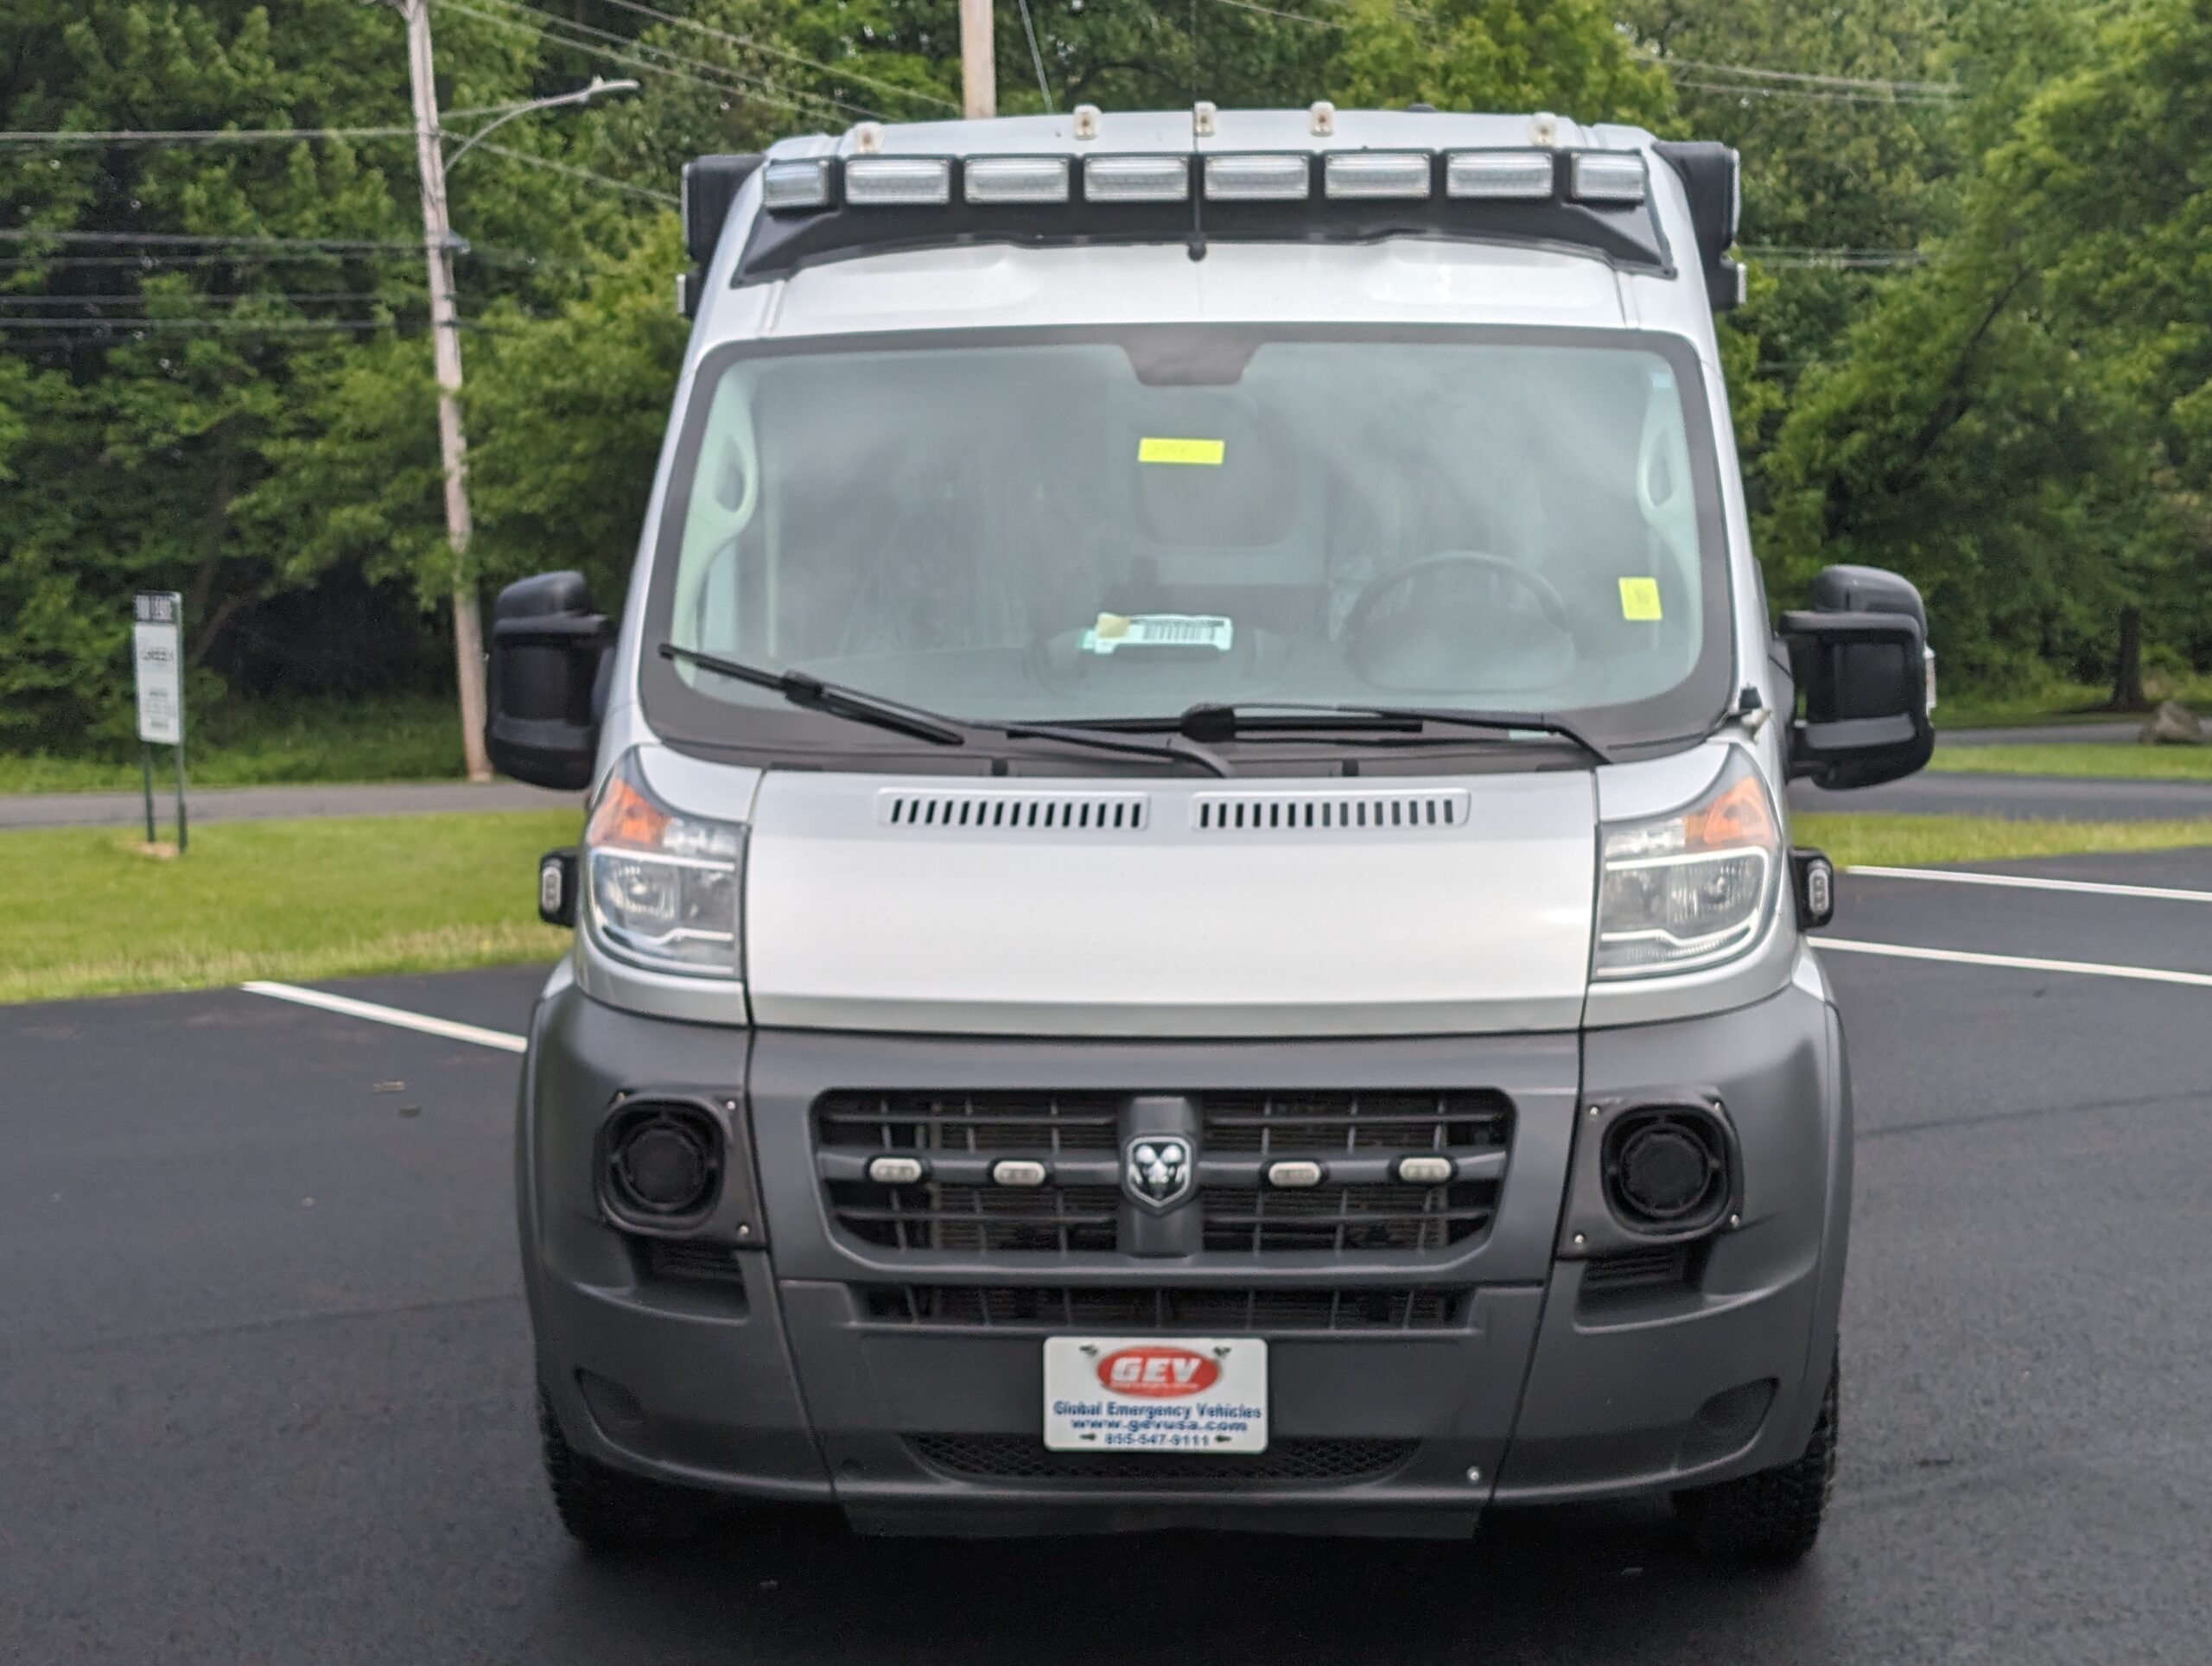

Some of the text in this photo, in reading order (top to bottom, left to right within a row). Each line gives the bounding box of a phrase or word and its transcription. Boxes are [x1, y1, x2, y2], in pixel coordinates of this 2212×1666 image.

[1109, 1357, 1202, 1383] GEV
[1053, 1401, 1262, 1420] Global Emergency Vehicles
[1071, 1420, 1248, 1432] www.gevusa.com
